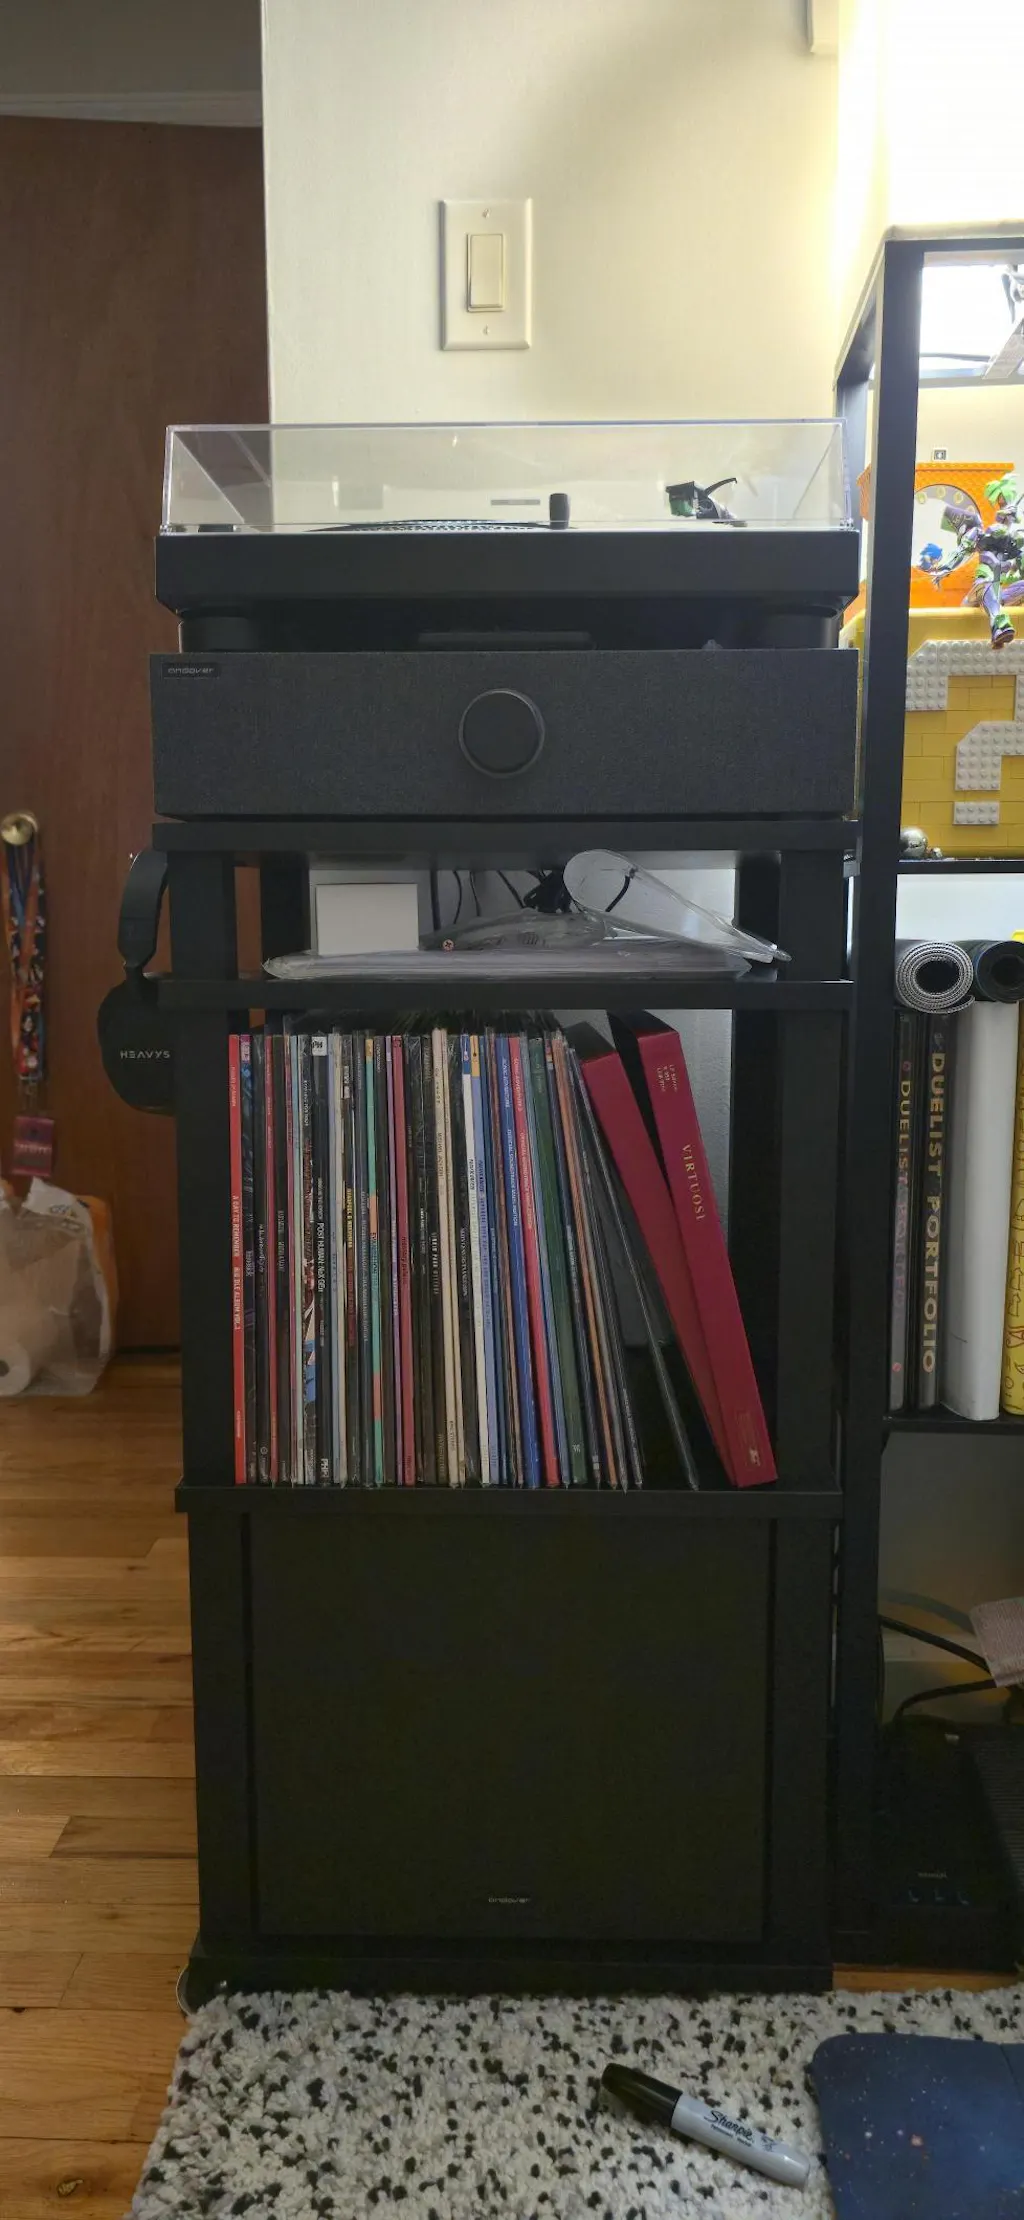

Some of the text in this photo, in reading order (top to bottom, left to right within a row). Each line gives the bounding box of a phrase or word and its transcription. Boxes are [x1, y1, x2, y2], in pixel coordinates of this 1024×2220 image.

[168, 667, 215, 675] andover
[119, 1050, 172, 1060] HEAVYS
[897, 1080, 912, 1188] DUELIST
[680, 1144, 706, 1221] VIRTUOSI
[922, 1052, 946, 1373] DUELIST PORTFOLIO
[316, 1222, 325, 1239] POST
[703, 2110, 754, 2142] Sharpie
